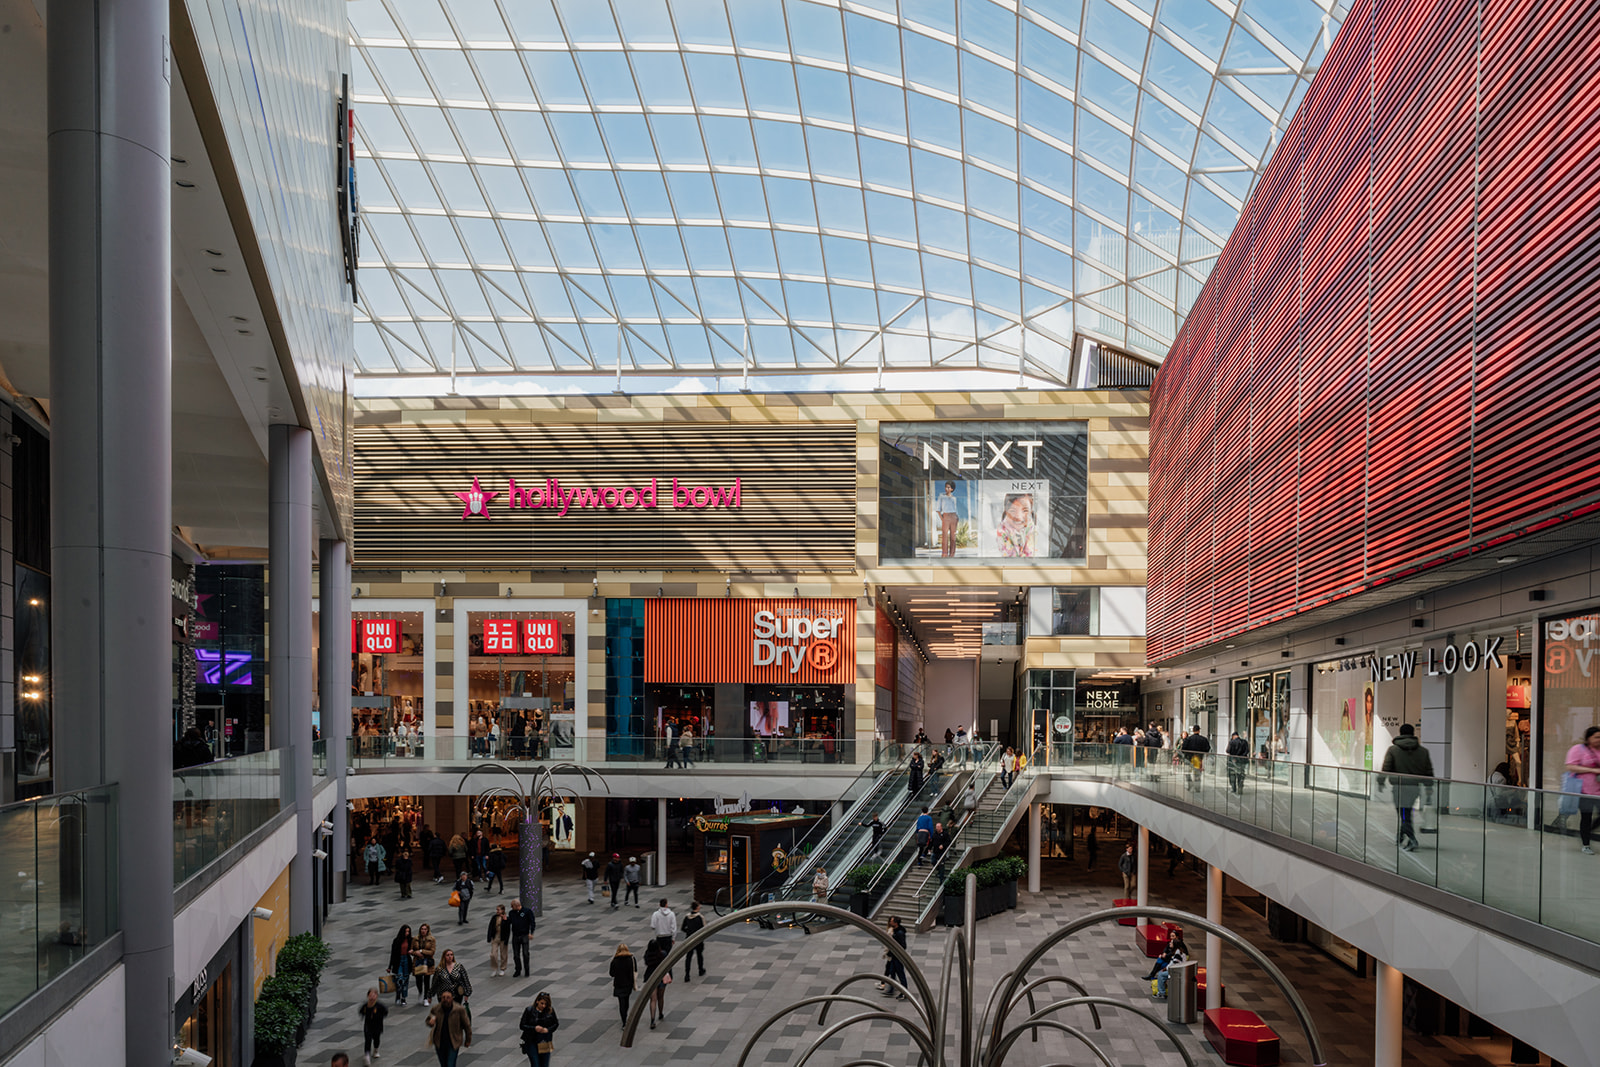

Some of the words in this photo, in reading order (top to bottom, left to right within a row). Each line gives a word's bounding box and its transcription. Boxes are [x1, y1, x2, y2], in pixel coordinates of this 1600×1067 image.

[923, 441, 1043, 470] NEXT
[1011, 482, 1043, 490] NEXT
[509, 478, 657, 516] hollywood
[672, 477, 741, 508] bowl
[366, 623, 390, 636] UNI
[488, 623, 513, 635] ユニ
[527, 623, 552, 636] UNI
[753, 610, 843, 646] Super
[366, 637, 393, 651] QLO
[487, 637, 513, 649] クロ
[527, 637, 554, 651] QLO
[1370, 651, 1418, 683] NEW
[1428, 636, 1504, 677] LOOK
[1249, 679, 1266, 694] NEXT
[1086, 690, 1120, 700] NEXT
[1247, 692, 1268, 709] BEAUTY
[1086, 700, 1119, 709] HOME
[696, 814, 729, 832] Churros
